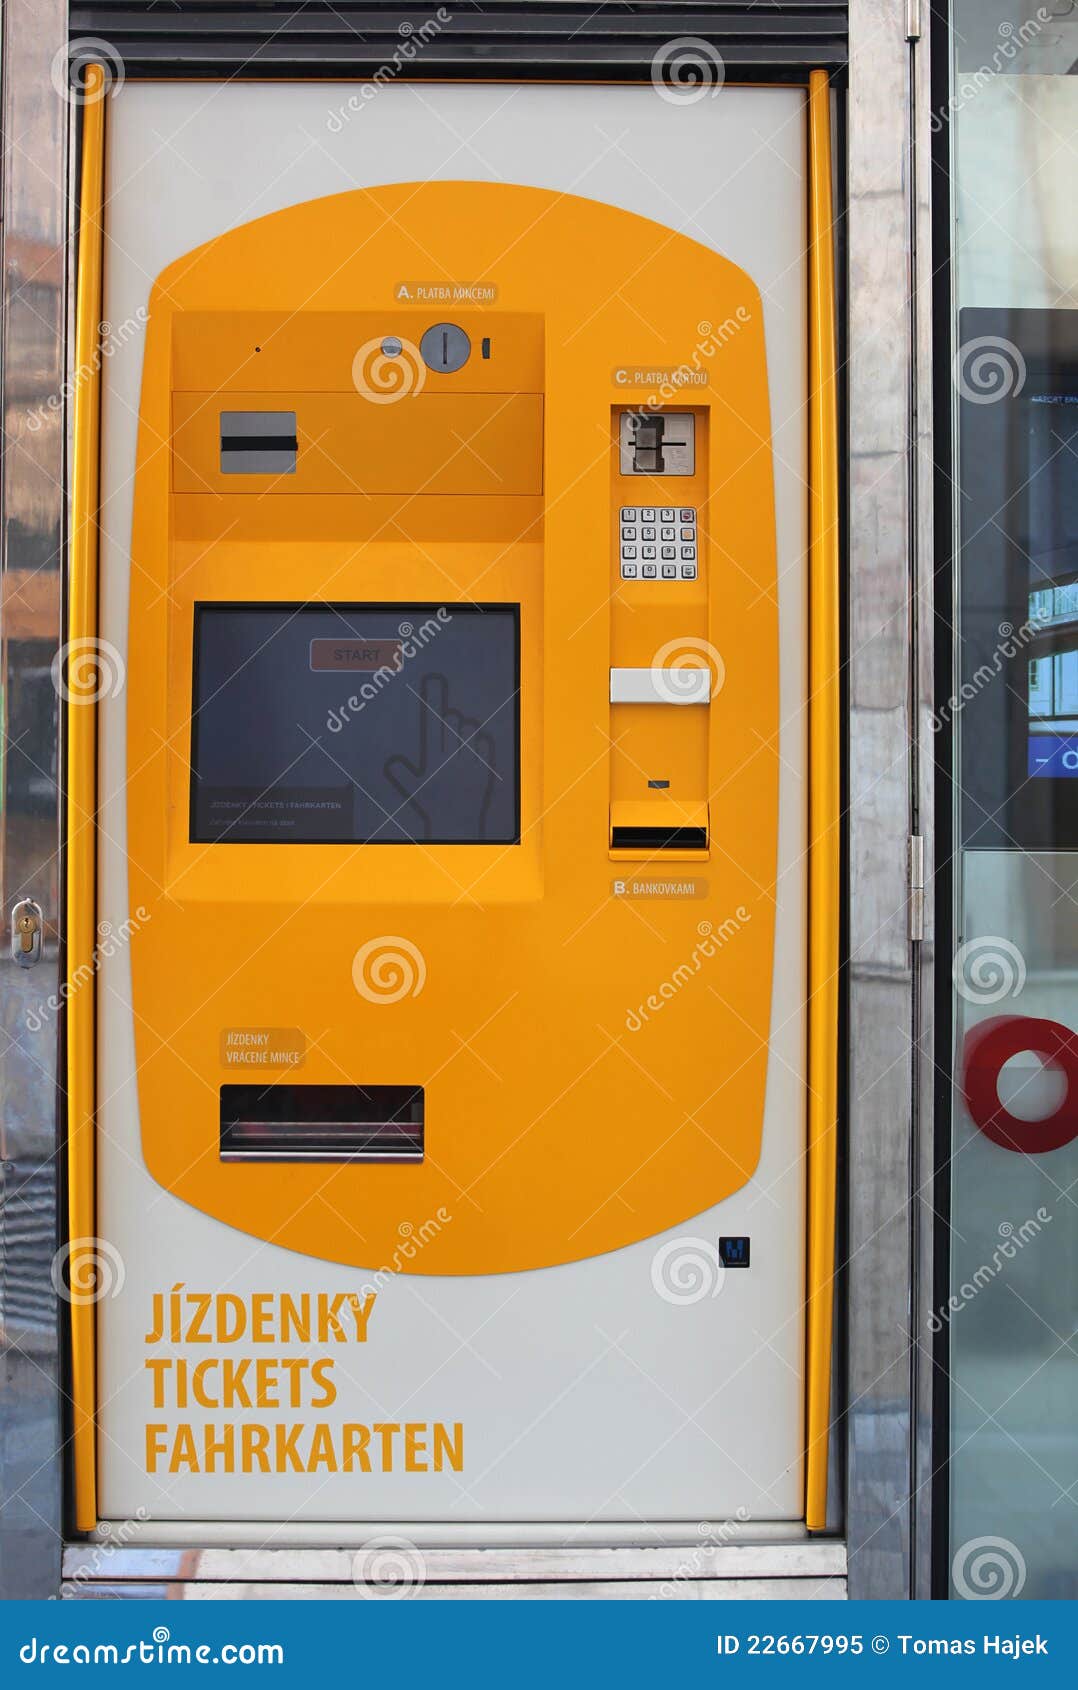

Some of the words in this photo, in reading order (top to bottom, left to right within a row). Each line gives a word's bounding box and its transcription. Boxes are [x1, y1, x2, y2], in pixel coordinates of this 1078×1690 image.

[397, 285, 414, 299] A.
[417, 287, 451, 299] PLATBA
[453, 287, 495, 299] MINCEMI
[615, 370, 632, 384] C.
[634, 372, 668, 384] PLATBA
[333, 649, 382, 662] START
[614, 881, 630, 894] B.
[633, 882, 695, 894] BANKOVKAMI
[226, 1032, 270, 1046] JÍZDENKY
[270, 1051, 299, 1063] MINCE
[144, 1282, 378, 1344] JÍZDENKY
[144, 1358, 338, 1409] TICKETS
[145, 1422, 464, 1473] FAHRKARTEN
